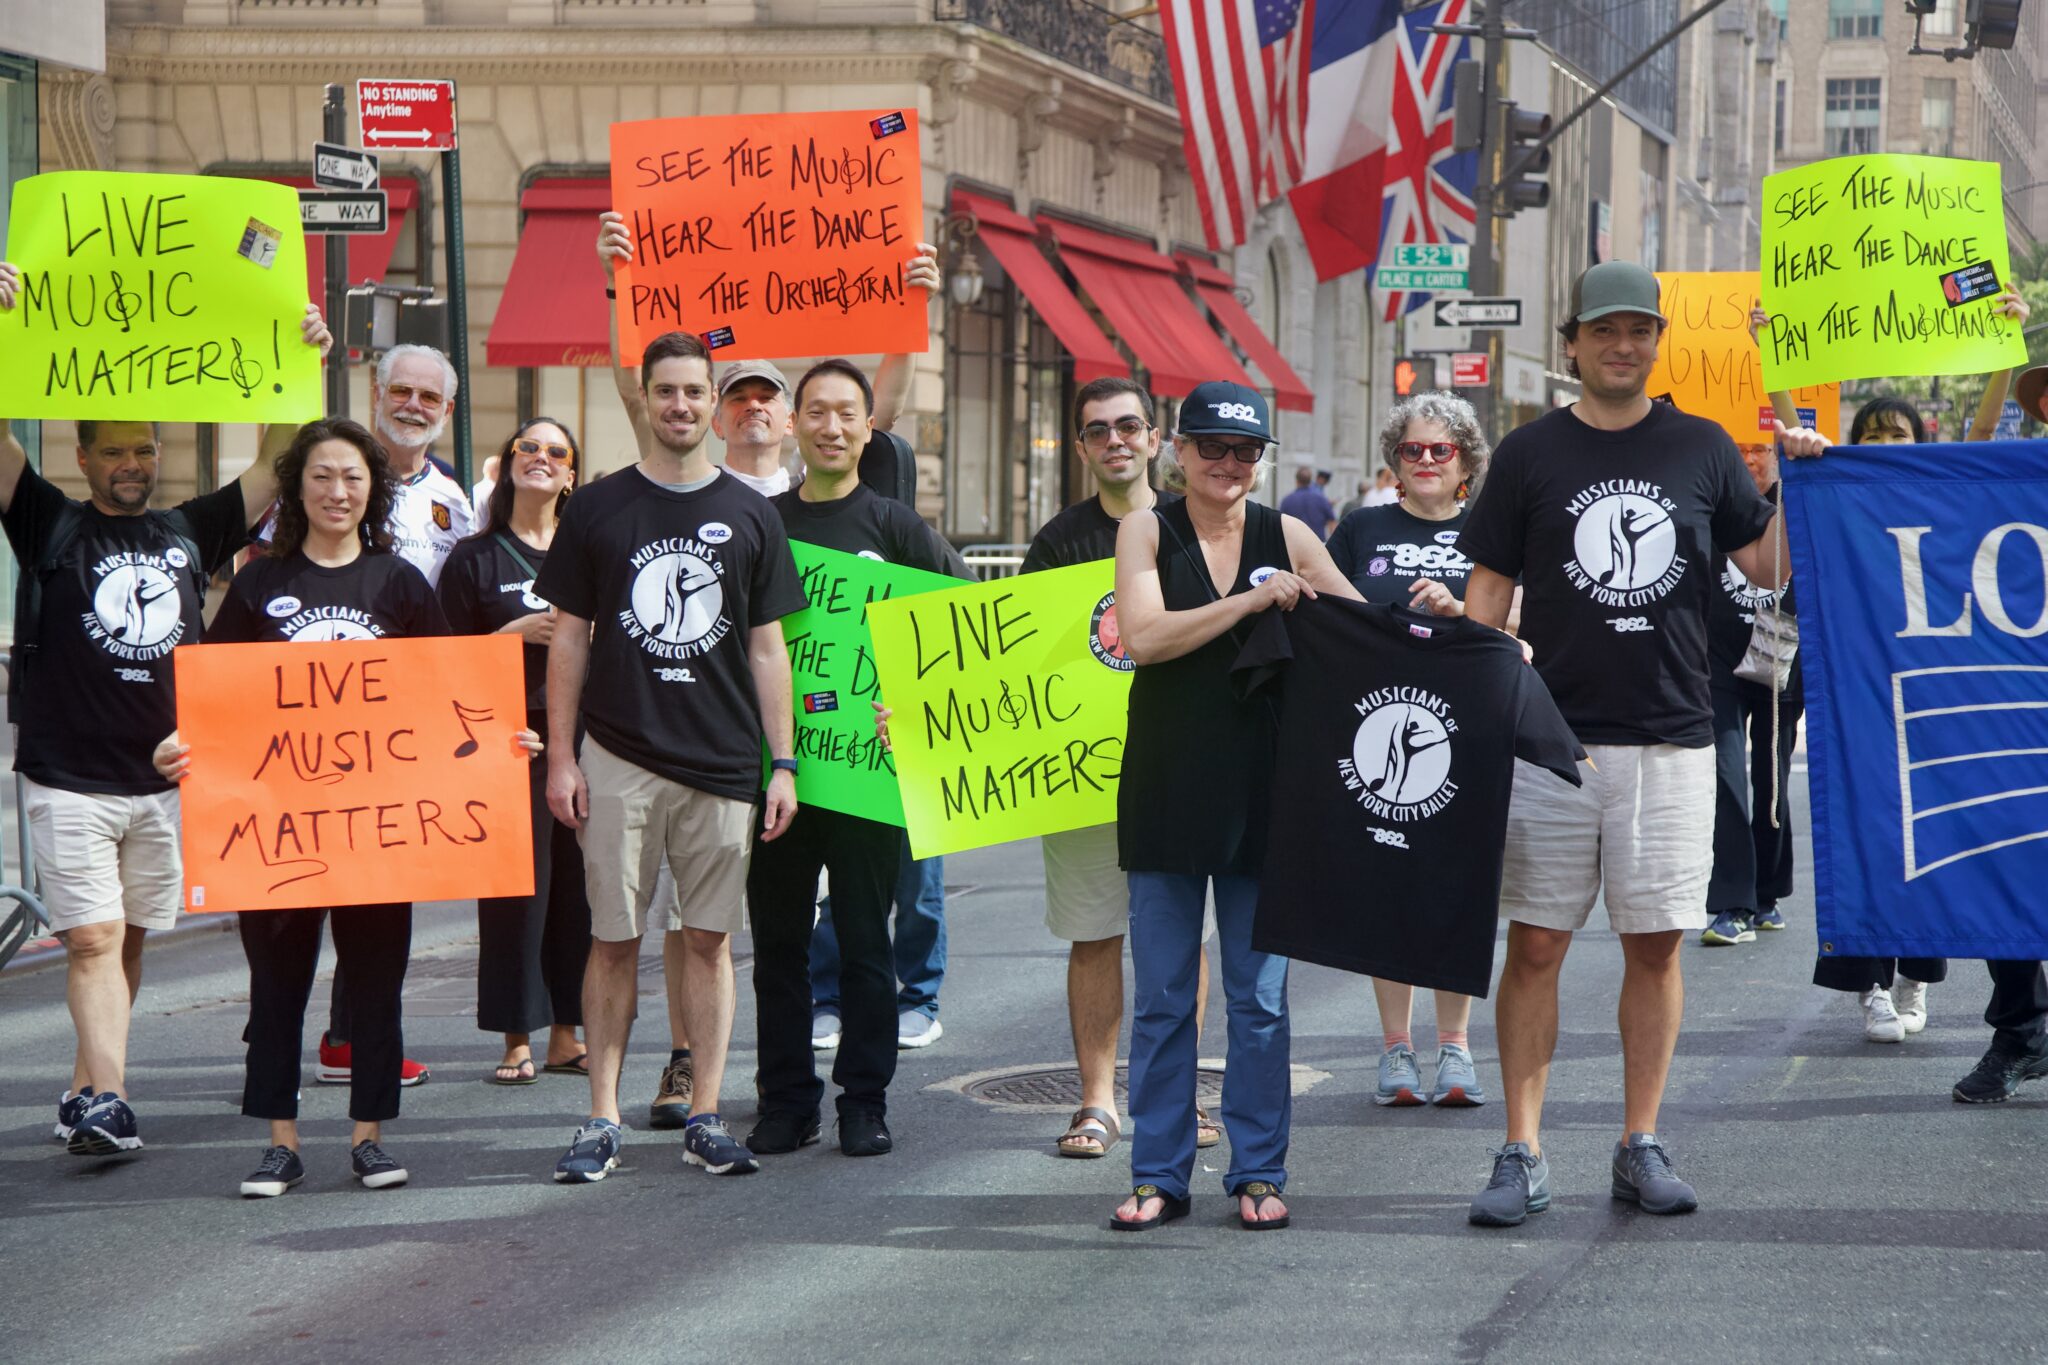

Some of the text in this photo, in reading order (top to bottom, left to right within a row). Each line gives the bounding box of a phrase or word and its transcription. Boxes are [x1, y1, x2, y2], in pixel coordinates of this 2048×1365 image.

[363, 87, 438, 102] NO STANDING
[365, 103, 412, 119] Anytime
[320, 157, 371, 181] ONE WAY
[636, 148, 711, 188] SEE
[722, 138, 774, 187] THE
[301, 204, 375, 220] NE WAY
[1775, 164, 1985, 228] SEE THE MUSIC
[62, 192, 195, 257] LIVE
[634, 202, 903, 267] HEAR THE DANCE
[1381, 271, 1410, 287] PLACE
[1398, 246, 1408, 266] E
[1416, 246, 1440, 266] 52
[1774, 224, 1981, 288] HEAR THE DANCE
[630, 283, 682, 326] PAY
[699, 272, 750, 315] THE
[1447, 306, 1511, 319] ONE WAY
[1770, 313, 1809, 365] PAY
[1818, 301, 1862, 344] THE
[1801, 419, 1815, 427] STRA
[1565, 479, 1678, 517] MUSICIANS OF
[630, 537, 725, 576] MUSICIANS OF
[1376, 544, 1396, 552] LOCAL
[500, 582, 522, 593] LOCAL
[801, 563, 851, 613] THE
[1394, 568, 1465, 579] New York City
[1563, 554, 1688, 608] NEW YORK CITY BALLET
[1720, 572, 1735, 592] NEW
[1730, 590, 1753, 608] YORK
[81, 611, 186, 661] NEW YORK CITY BALLET
[280, 605, 386, 636] MUSICIANS OF
[619, 609, 732, 660] NEW YORK CITY BALLET
[910, 593, 1038, 680] LIVE
[786, 632, 835, 677] THE
[1090, 634, 1104, 653] NEW
[1100, 651, 1121, 668] YORK
[275, 658, 388, 709] LIVE
[1354, 686, 1459, 733] MUSICIANS OF
[253, 728, 417, 785] MUSIC
[941, 736, 1122, 820] MATTERS
[1337, 758, 1459, 822] NEW YORK CITY BALLET
[219, 799, 488, 890] MATTERS
